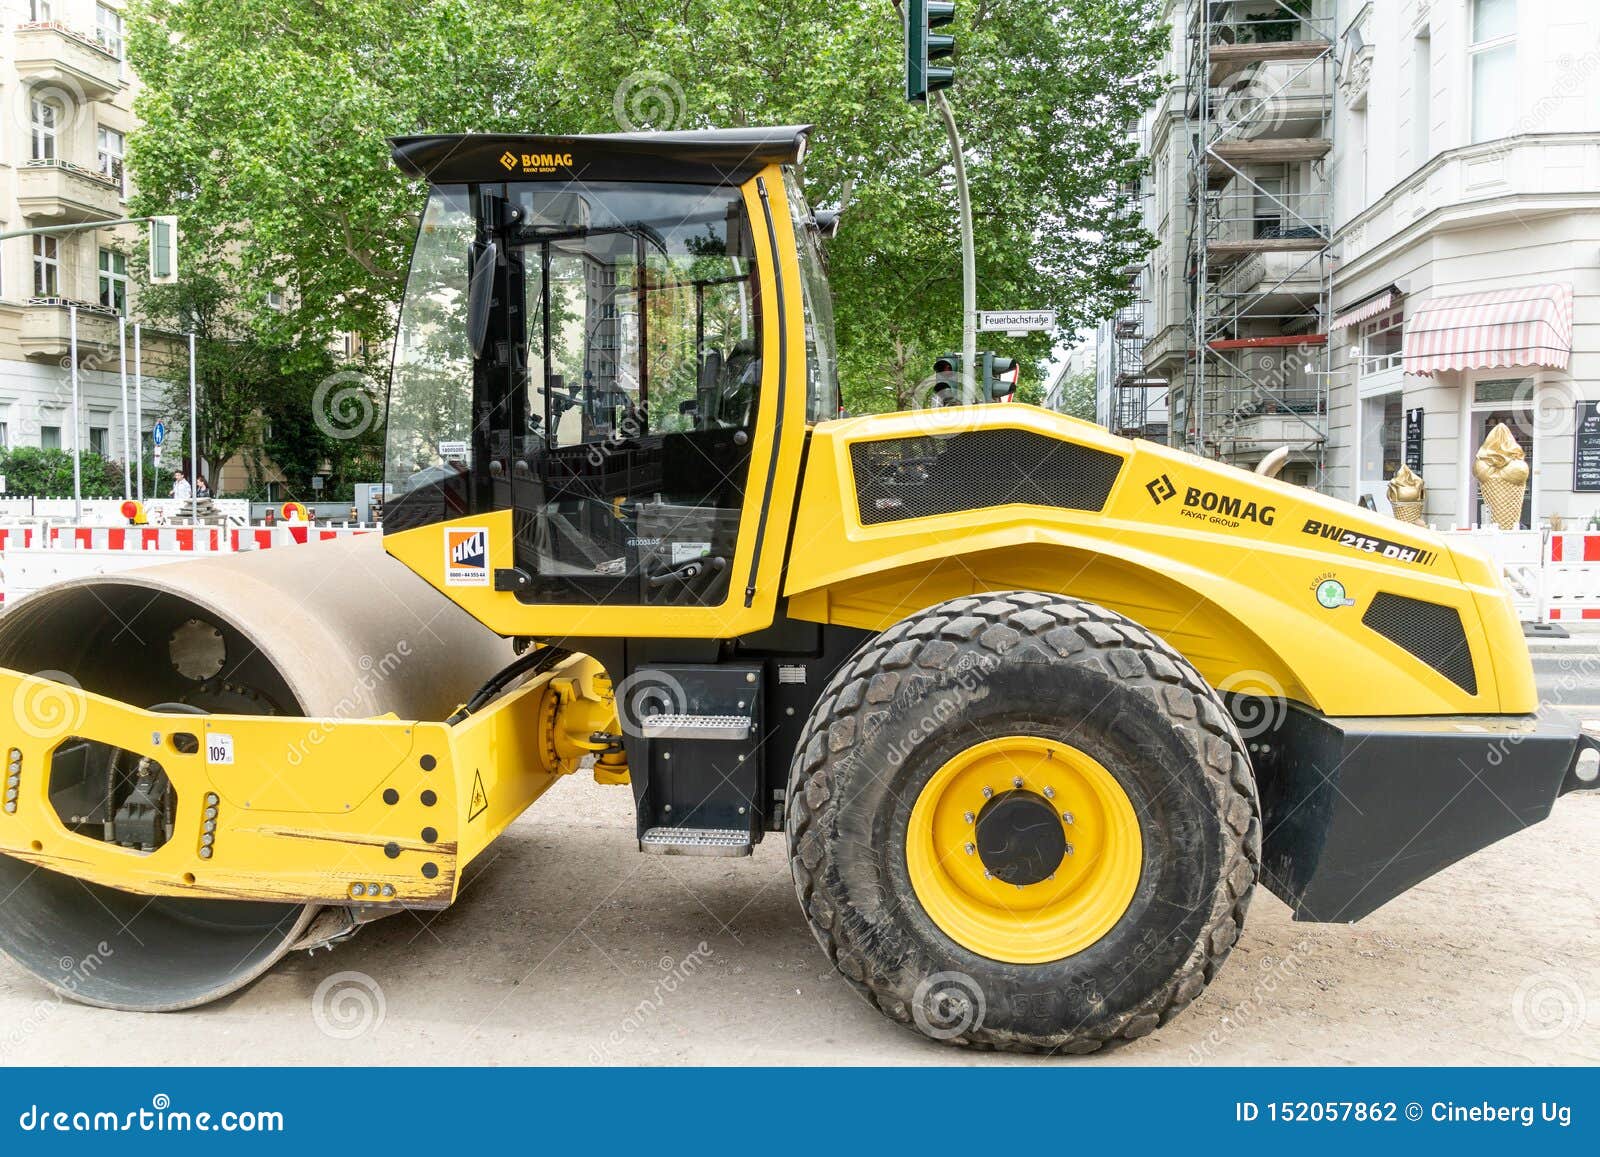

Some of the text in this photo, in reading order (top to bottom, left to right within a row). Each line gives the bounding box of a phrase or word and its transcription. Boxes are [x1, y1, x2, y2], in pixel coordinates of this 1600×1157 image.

[521, 153, 573, 167] BOMAG
[985, 314, 1049, 326] Feuerbachstraße
[1184, 486, 1276, 526] BOMAG
[1181, 509, 1240, 529] FAYAT GROUP
[452, 532, 484, 563] HKL
[209, 746, 226, 761] 109
